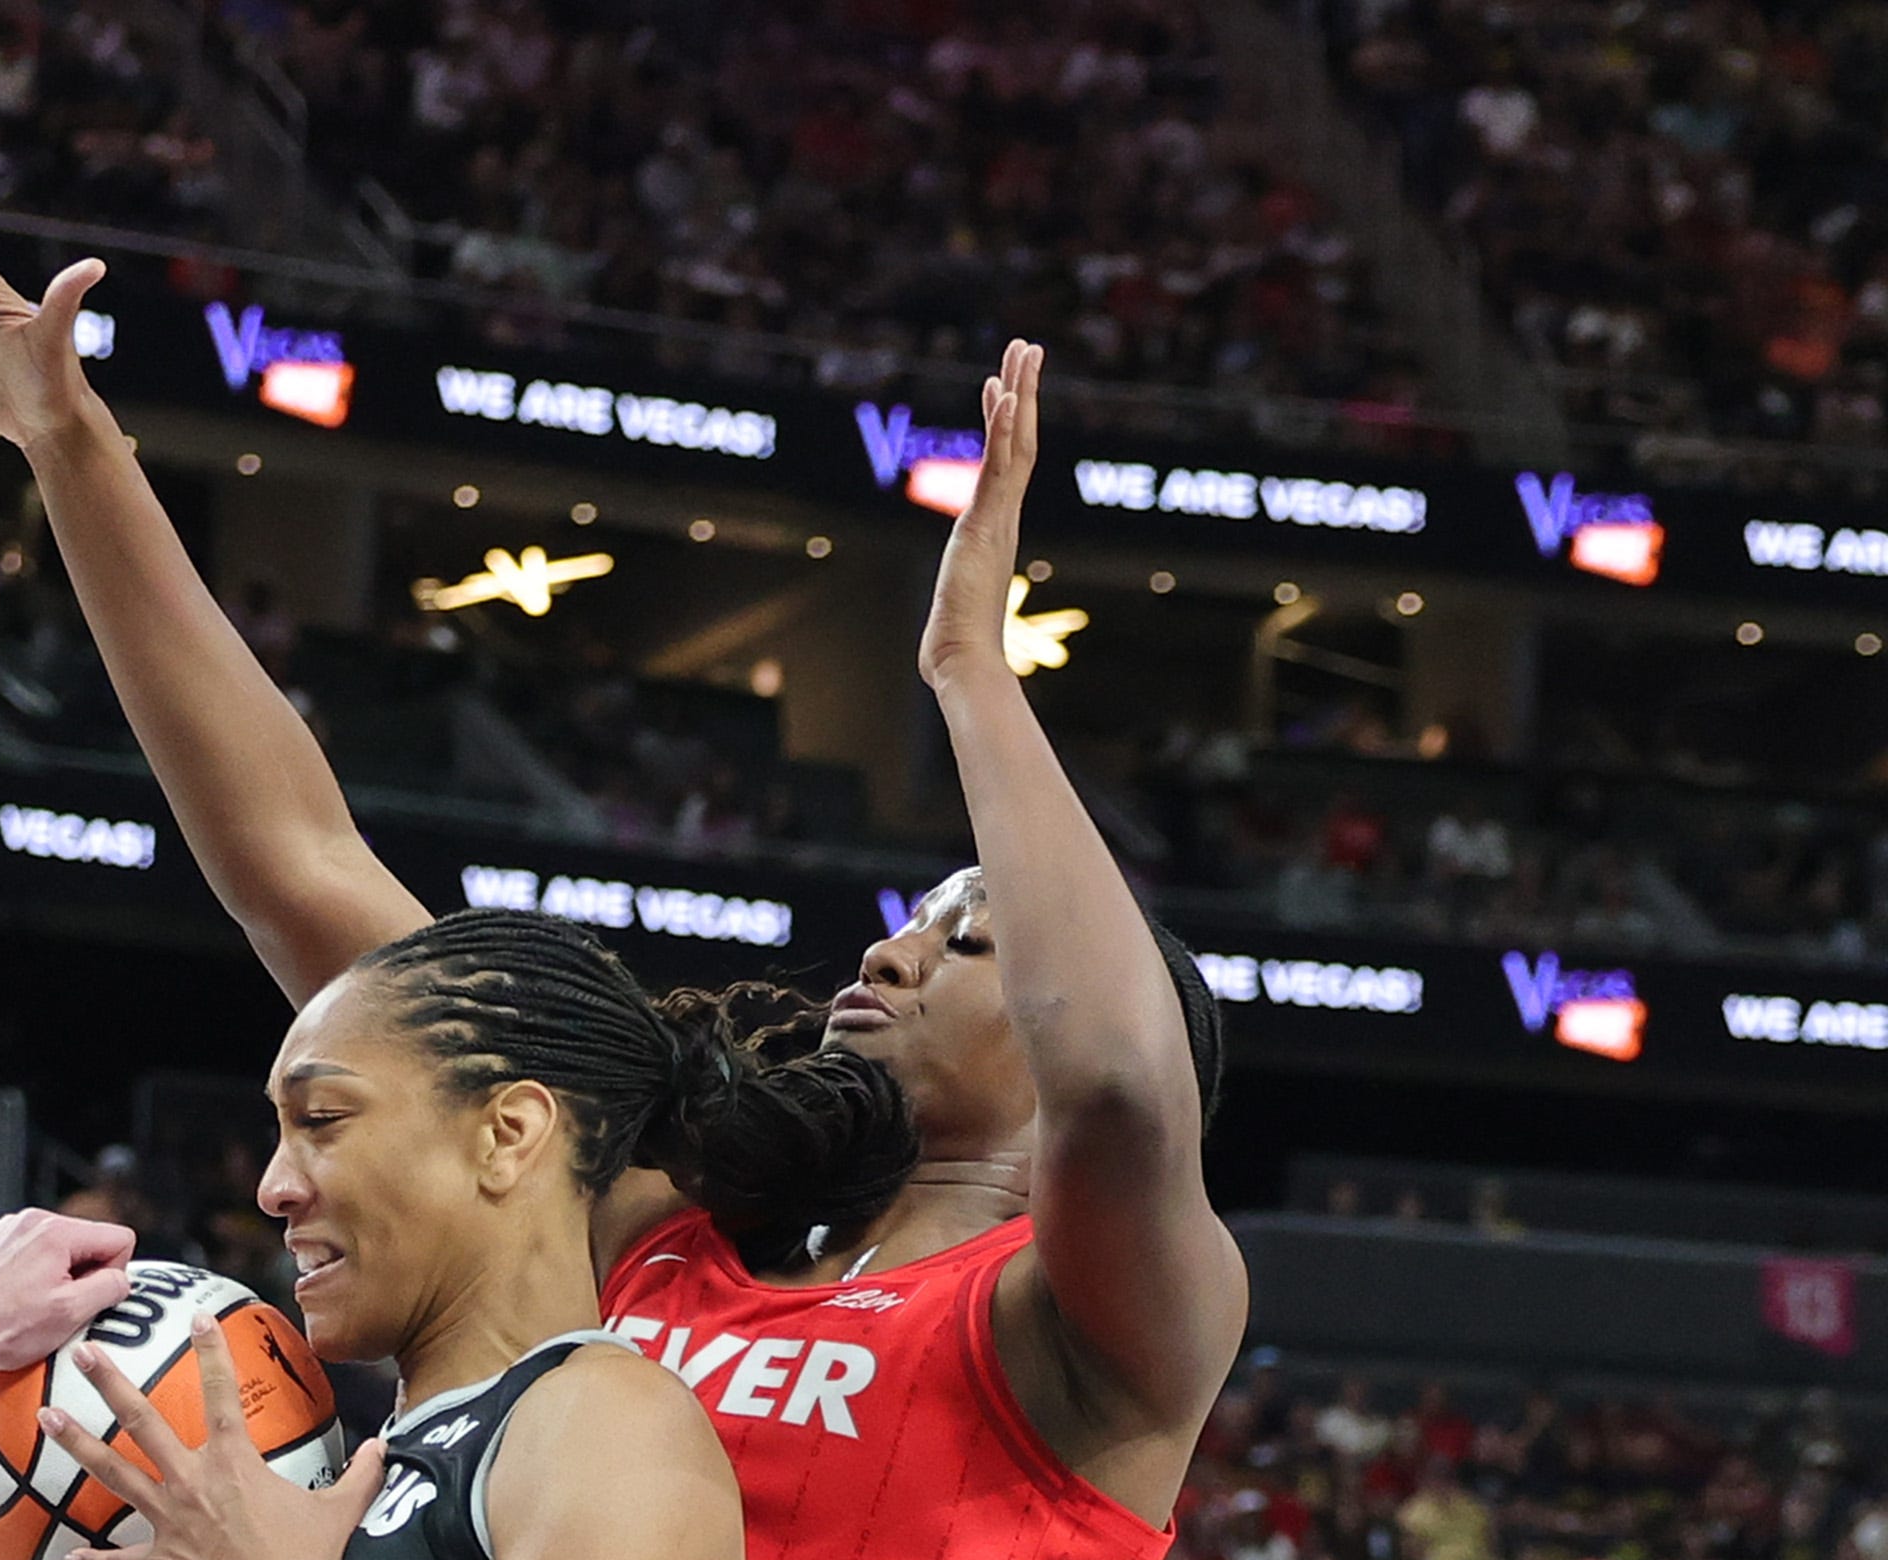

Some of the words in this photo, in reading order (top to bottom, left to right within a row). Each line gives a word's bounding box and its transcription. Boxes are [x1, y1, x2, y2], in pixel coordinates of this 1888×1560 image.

[436, 365, 516, 421] WE
[517, 380, 614, 436] ARE
[615, 393, 776, 460] VEGAS!
[1074, 459, 1157, 511] WE
[1158, 468, 1259, 519] ARE
[1744, 520, 1825, 570] WE
[1825, 527, 1888, 576] AR
[461, 865, 540, 911] WE
[540, 874, 634, 929] ARE
[635, 886, 792, 947] VEGAS!
[1195, 953, 1260, 1002] RE
[1722, 994, 1802, 1042] WE
